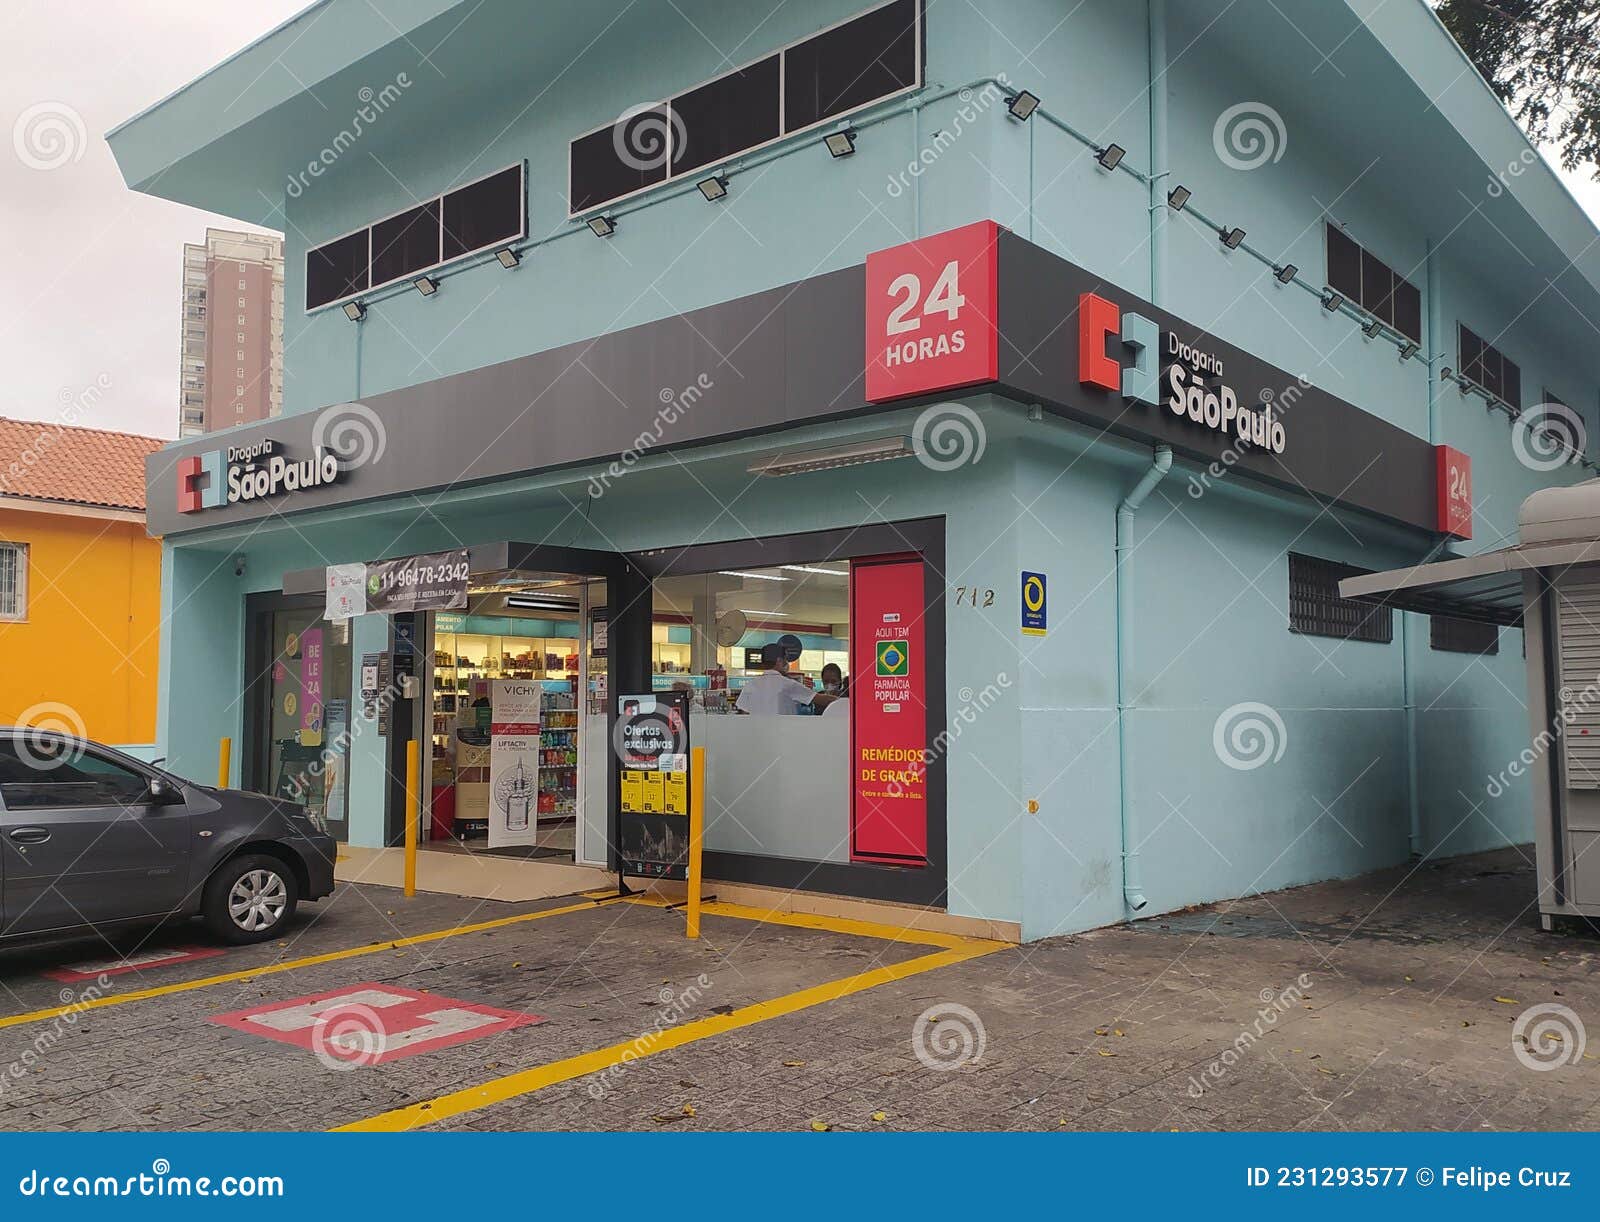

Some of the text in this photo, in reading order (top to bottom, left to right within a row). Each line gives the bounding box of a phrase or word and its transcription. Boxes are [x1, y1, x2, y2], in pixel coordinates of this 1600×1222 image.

[886, 260, 966, 336] 24
[886, 329, 966, 367] HORAS
[1169, 331, 1223, 376] Drogaria
[227, 438, 272, 463] Drogaria
[1451, 466, 1467, 503] 24
[381, 562, 469, 588] 11 96478-2342
[956, 585, 995, 608] 712
[875, 627, 909, 638] AQUI TEM
[308, 644, 320, 658] BE
[308, 663, 319, 676] LE
[874, 677, 910, 689] FARMÁCIA
[504, 686, 535, 695] VICHY
[875, 690, 910, 700] POPULAR
[624, 725, 660, 736] Ofertas
[624, 738, 673, 749] exclusivas
[862, 746, 924, 762] REMÉDIOS
[862, 769, 876, 782] DE
